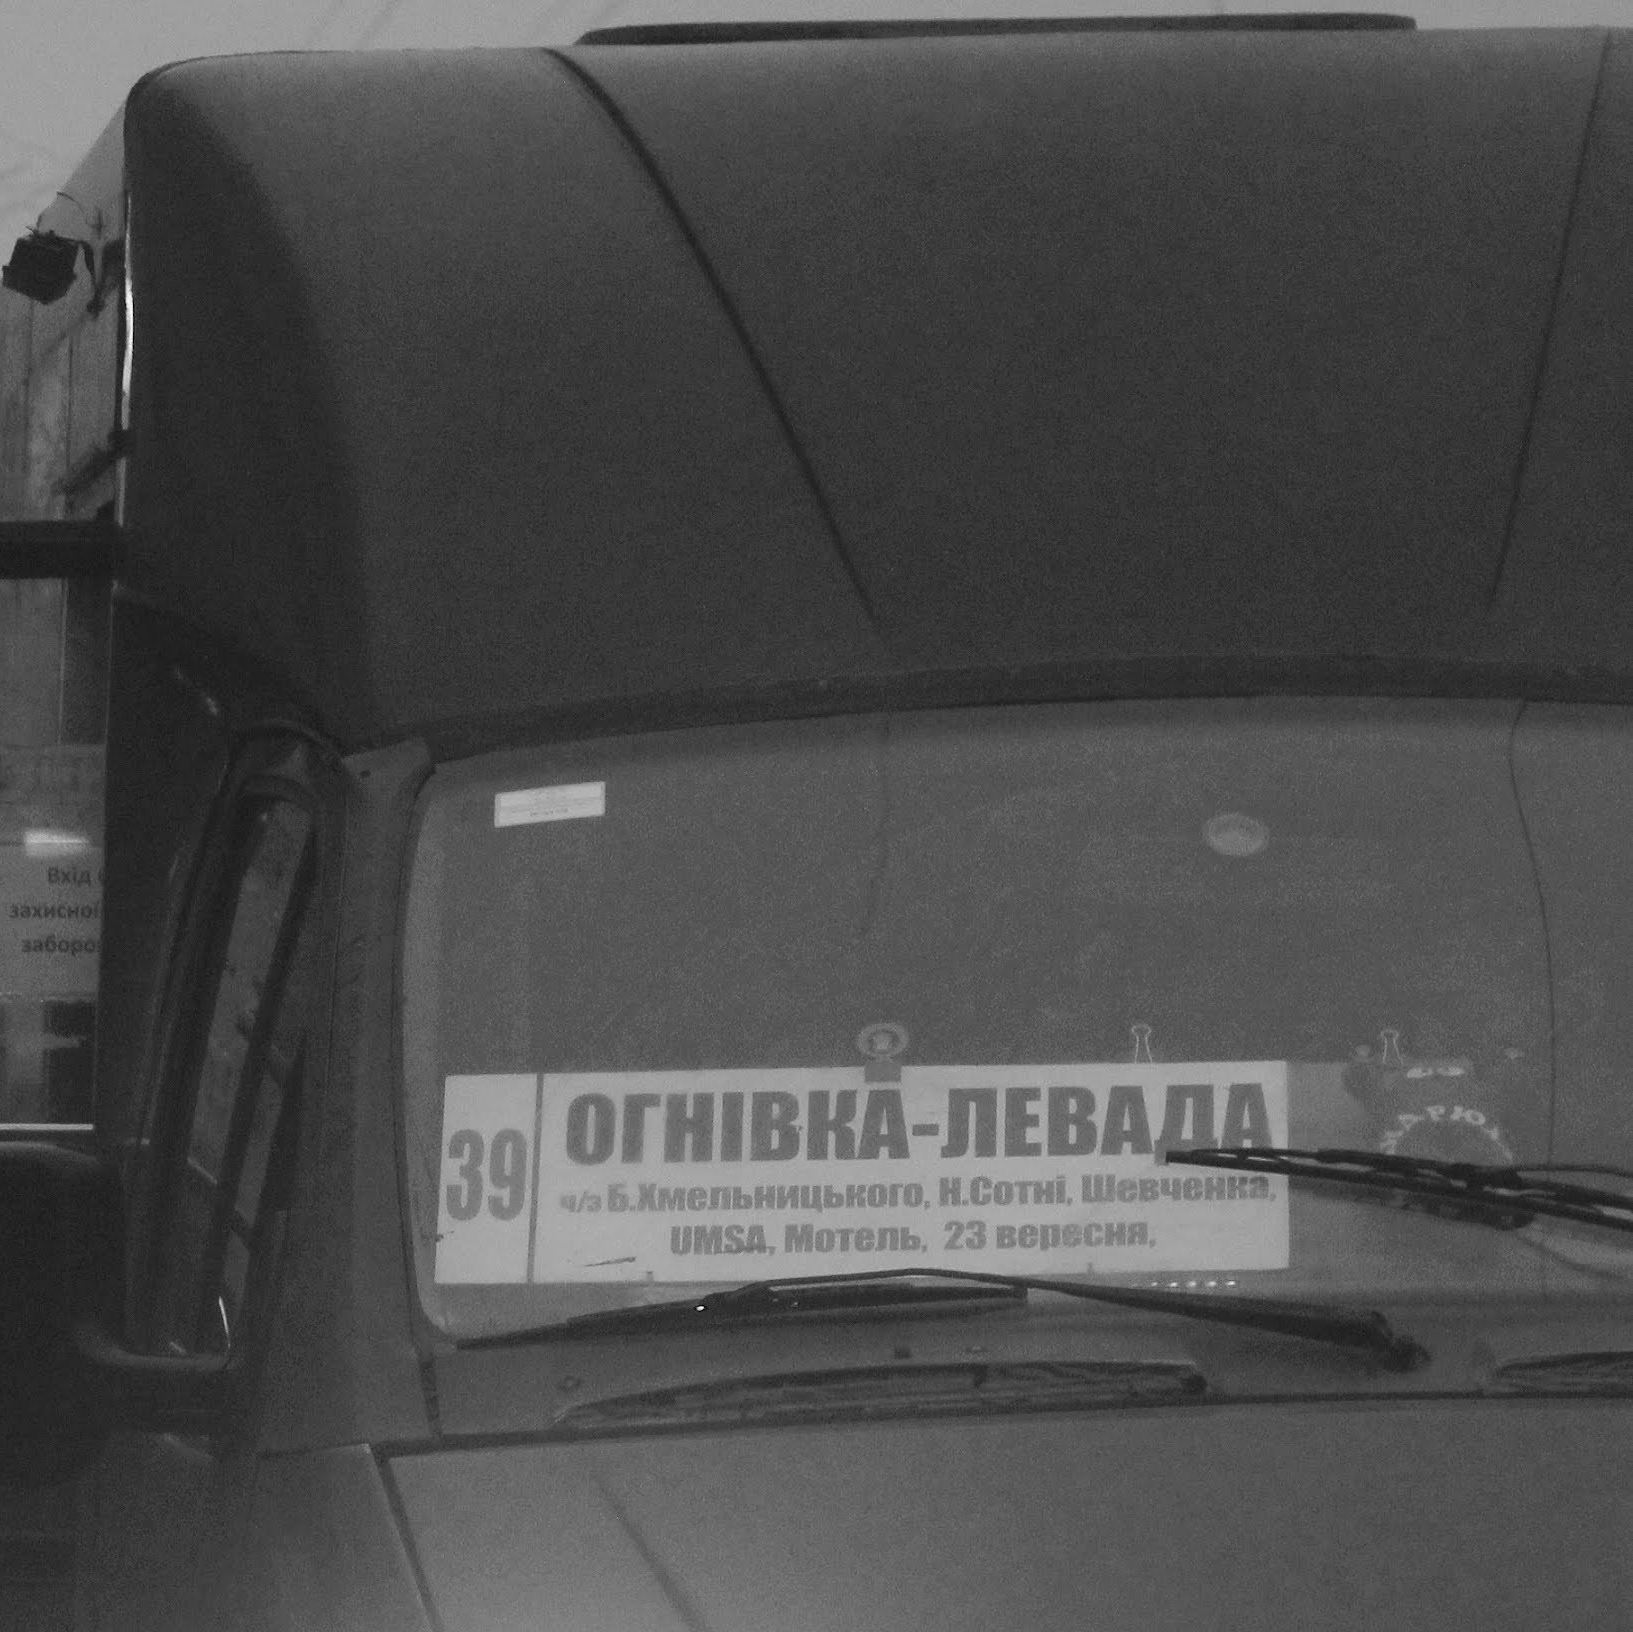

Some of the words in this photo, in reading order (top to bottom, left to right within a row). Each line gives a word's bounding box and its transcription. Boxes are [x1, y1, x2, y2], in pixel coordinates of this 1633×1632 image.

[48, 866, 91, 887] Вхід
[22, 933, 100, 957] заборо
[566, 1083, 1275, 1166] ОГНІВКА-ЛЕВАДА
[446, 1127, 528, 1222] 39
[559, 1192, 602, 1214] ч/з
[607, 1182, 931, 1213] Б.Хмельницького,
[939, 1175, 1073, 1207] Н.Сотні,
[1081, 1173, 1277, 1205] Шевченка,
[670, 1224, 776, 1257] UMSA,
[785, 1223, 927, 1254] Мотель,
[944, 1219, 988, 1251] 23
[996, 1220, 1158, 1253] вересня,
